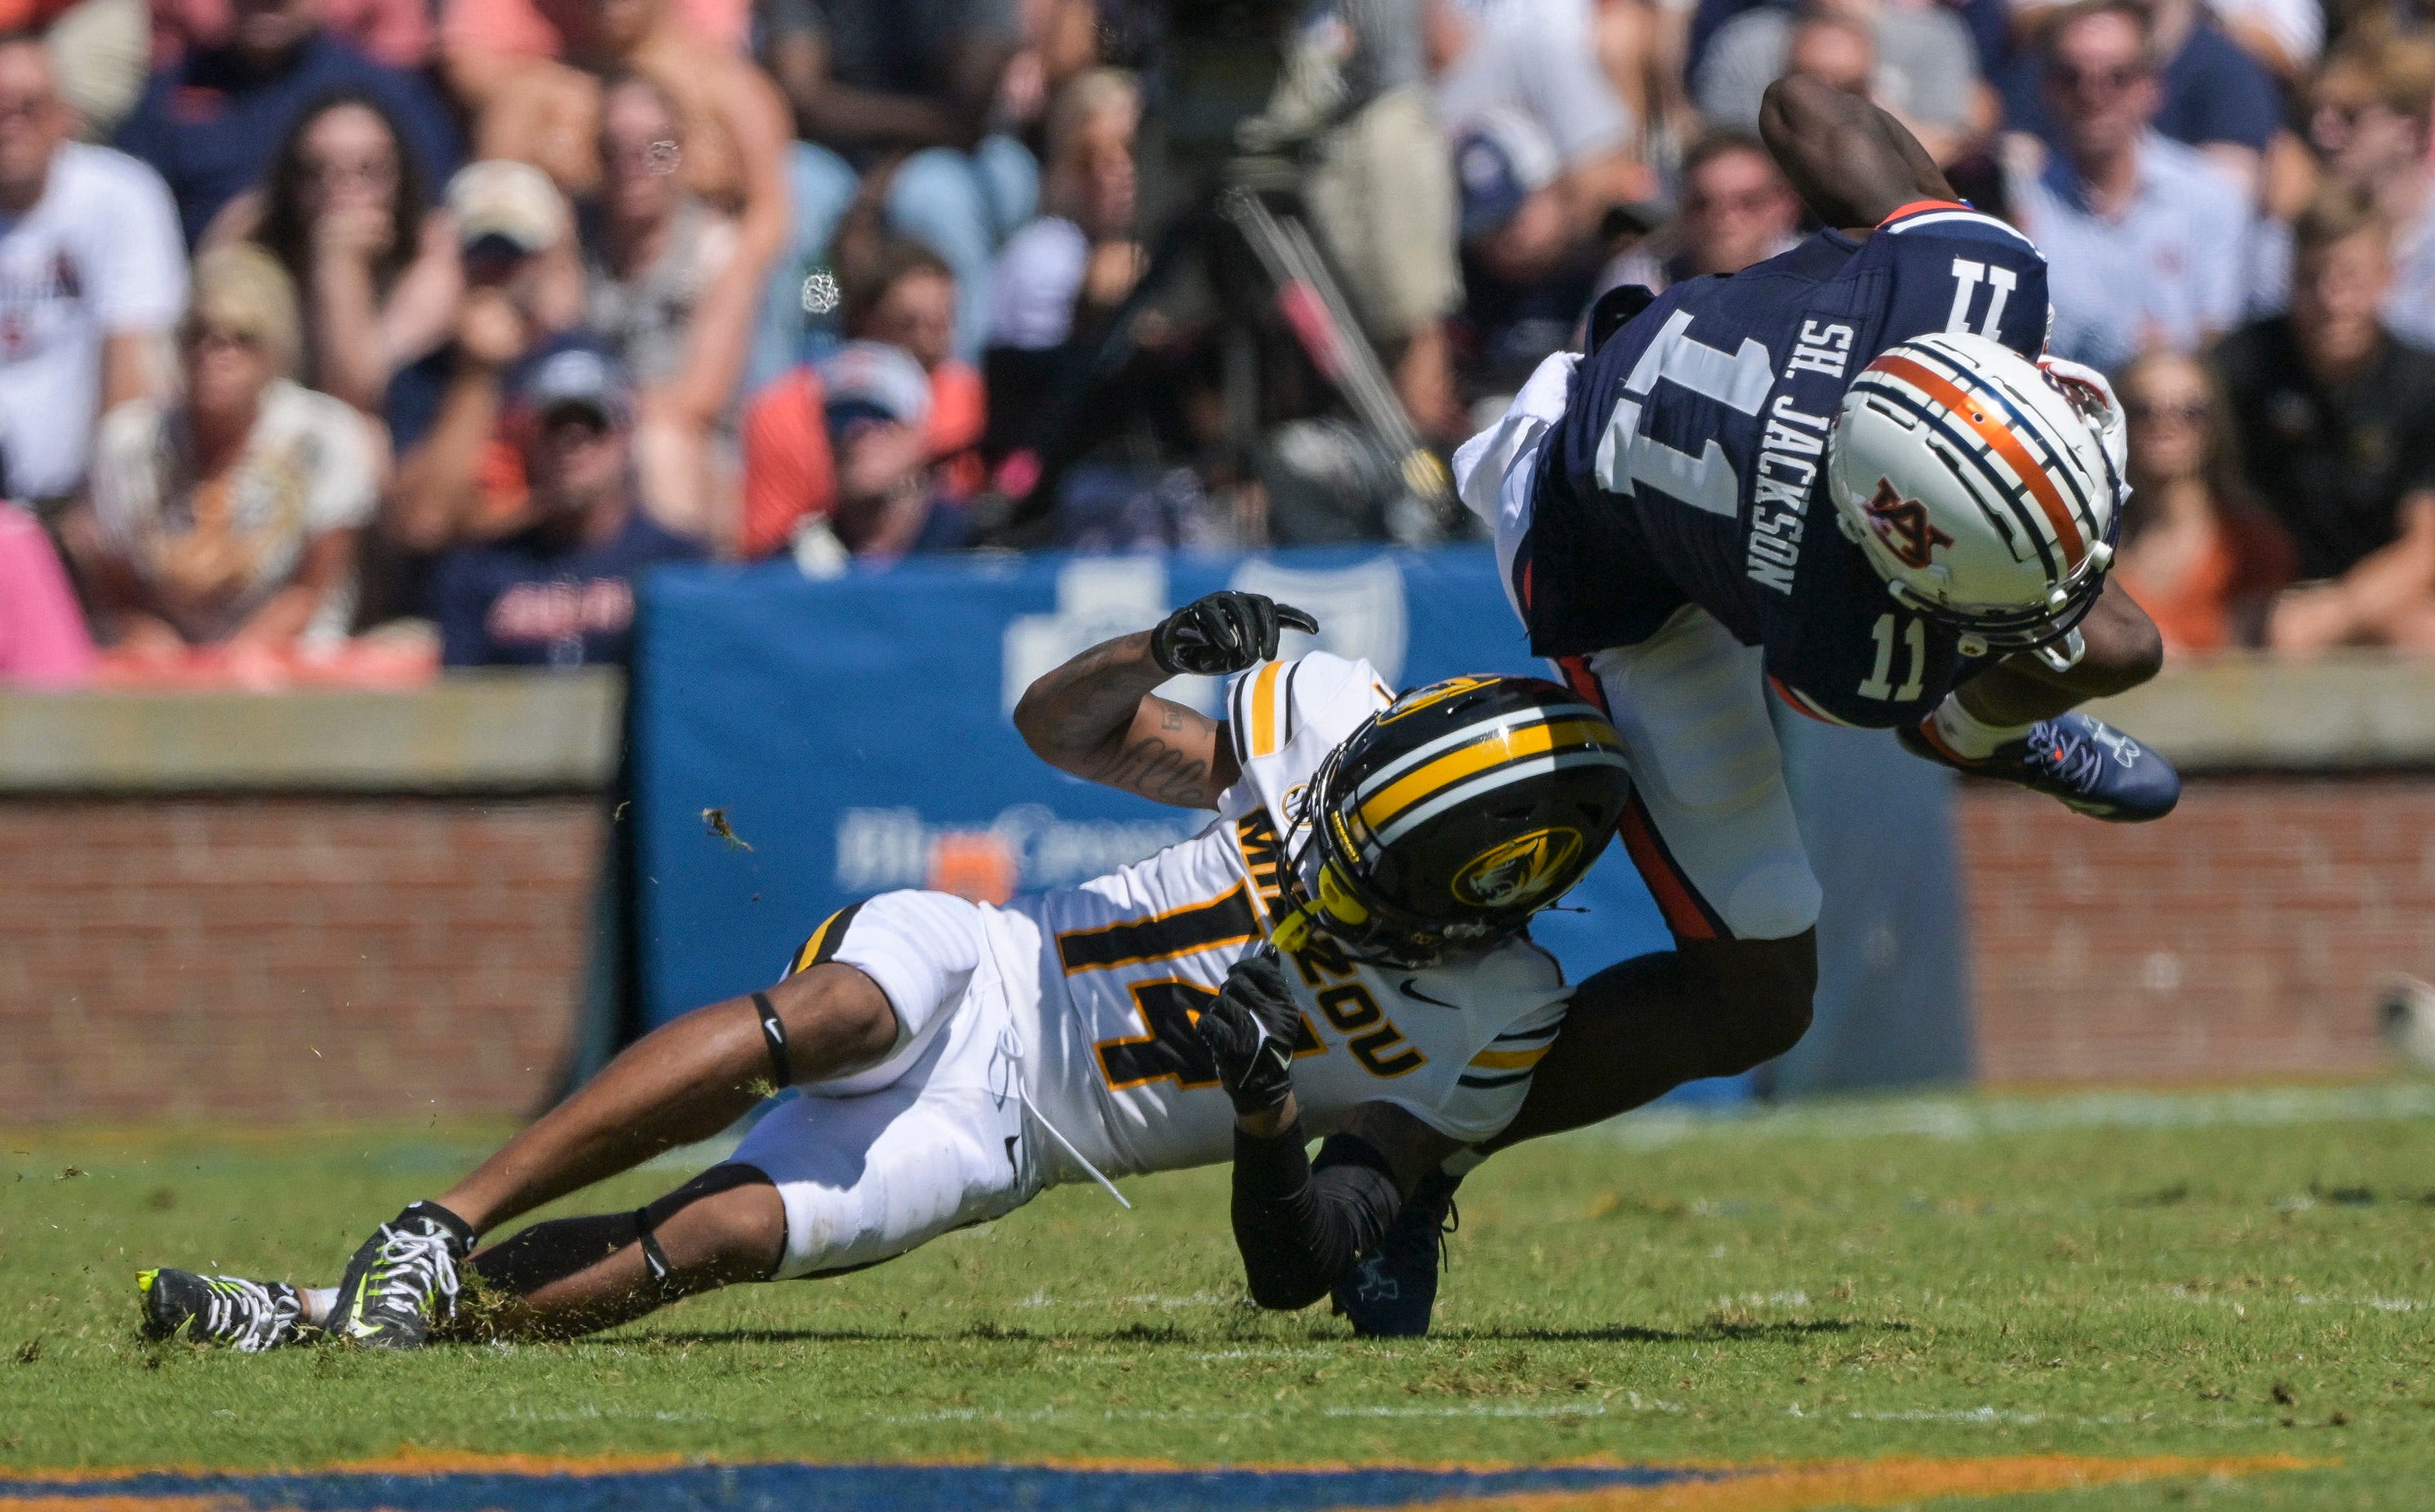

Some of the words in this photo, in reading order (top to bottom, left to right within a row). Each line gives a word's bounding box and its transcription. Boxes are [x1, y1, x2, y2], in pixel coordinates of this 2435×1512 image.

[1785, 319, 1854, 379] SH.
[1945, 258, 2017, 343] 11
[1595, 308, 1775, 519] 11
[1747, 396, 1830, 596] JACKSON
[1857, 614, 1925, 702] 11
[1055, 876, 1328, 1092] 14
[1235, 805, 1429, 1080] MIZOU
